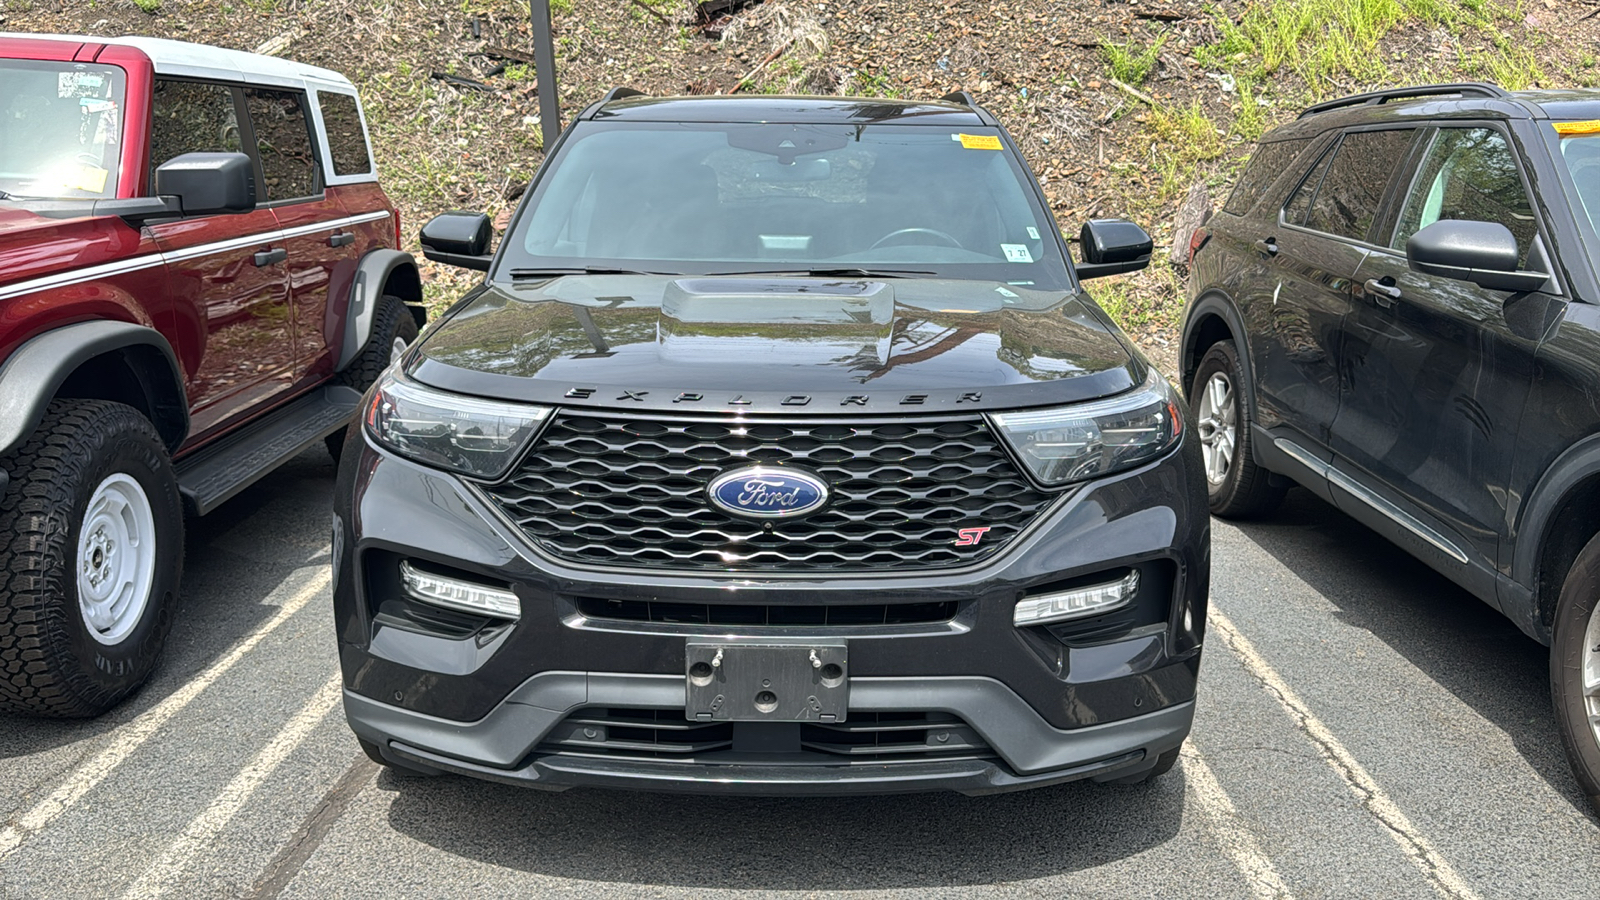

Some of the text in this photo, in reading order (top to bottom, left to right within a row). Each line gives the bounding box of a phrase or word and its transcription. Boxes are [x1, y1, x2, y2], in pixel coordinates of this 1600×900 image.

[1017, 249, 1027, 257] 27
[563, 386, 983, 405] EXPLORER
[737, 479, 800, 507] Ford
[955, 526, 991, 546] ST
